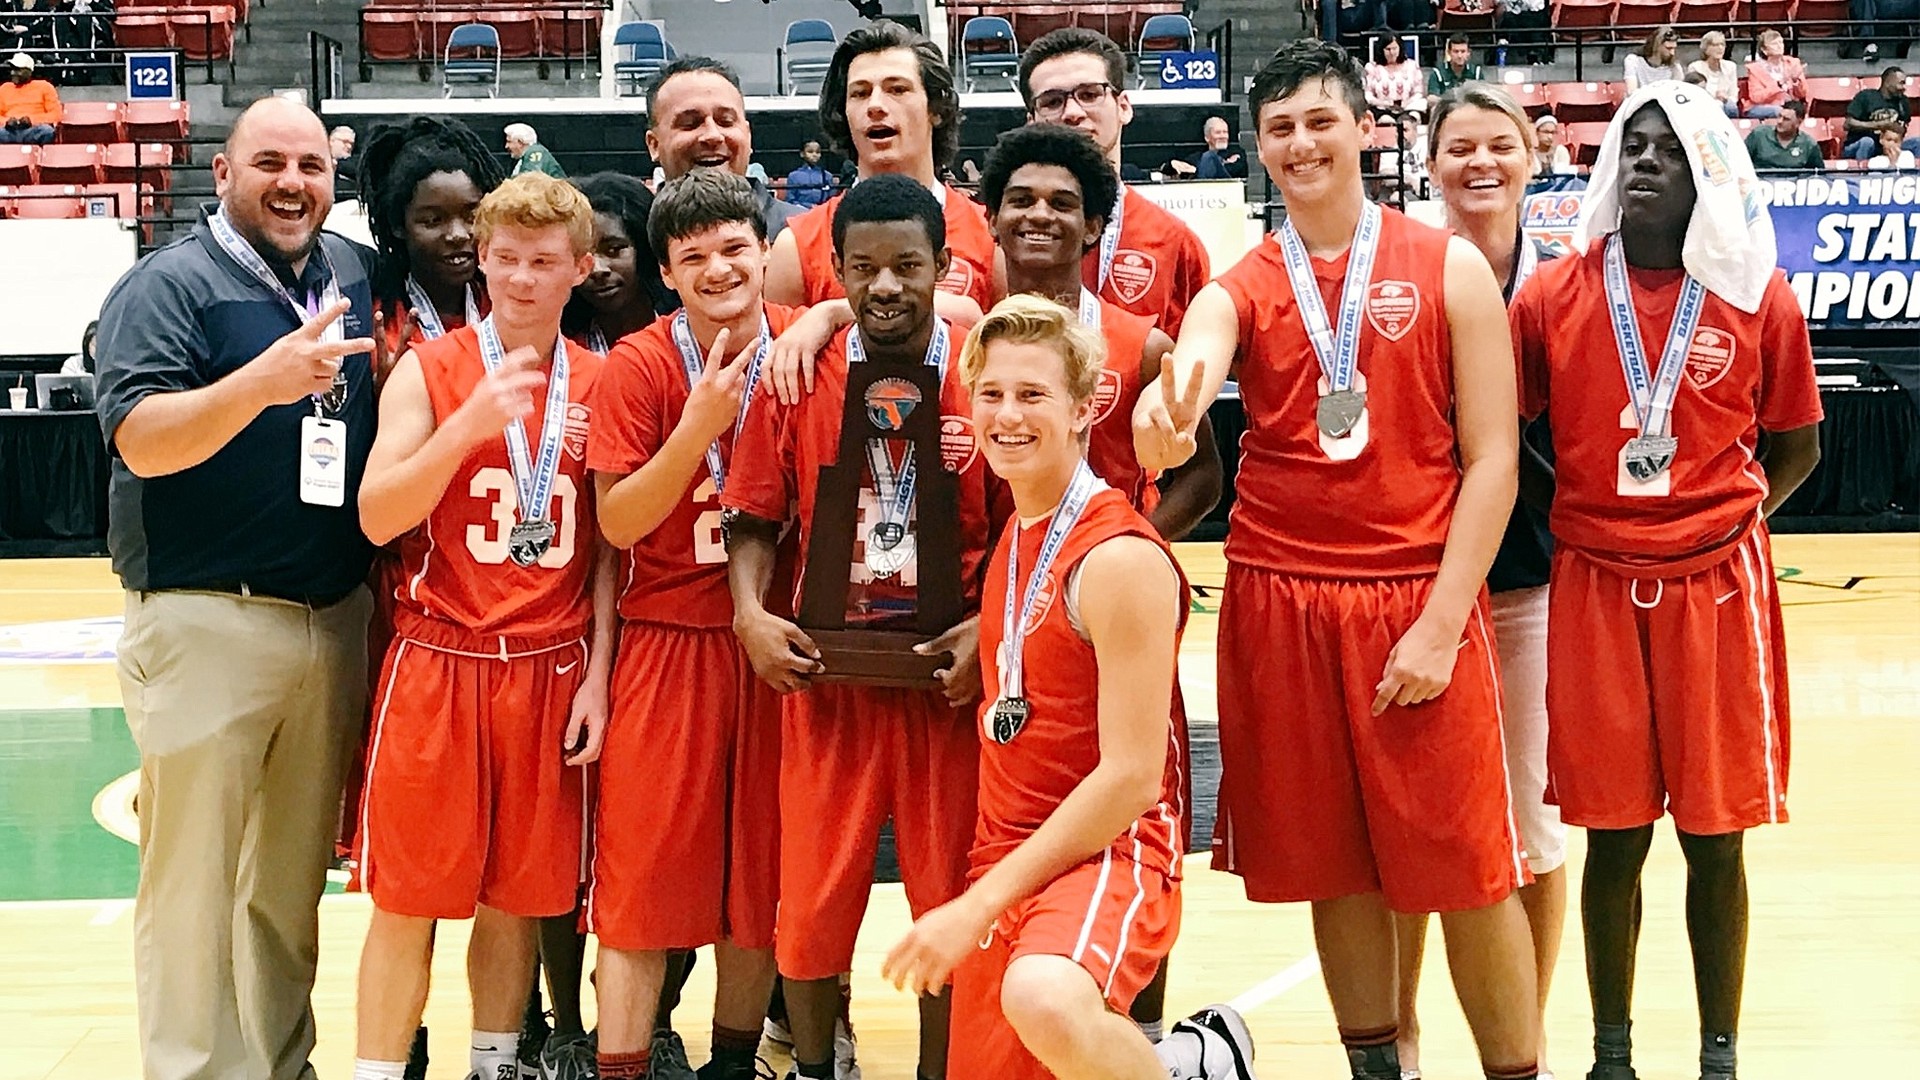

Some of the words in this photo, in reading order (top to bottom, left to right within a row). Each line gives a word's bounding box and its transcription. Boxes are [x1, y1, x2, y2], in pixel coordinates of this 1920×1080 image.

[133, 67, 168, 86] 122
[1184, 60, 1216, 80] 123
[1858, 176, 1920, 206] HIG
[1337, 299, 1358, 386] BASKETBALL
[1616, 303, 1645, 391] BASKETBALL
[465, 466, 578, 569] 30
[532, 435, 556, 519] BASKETBALL
